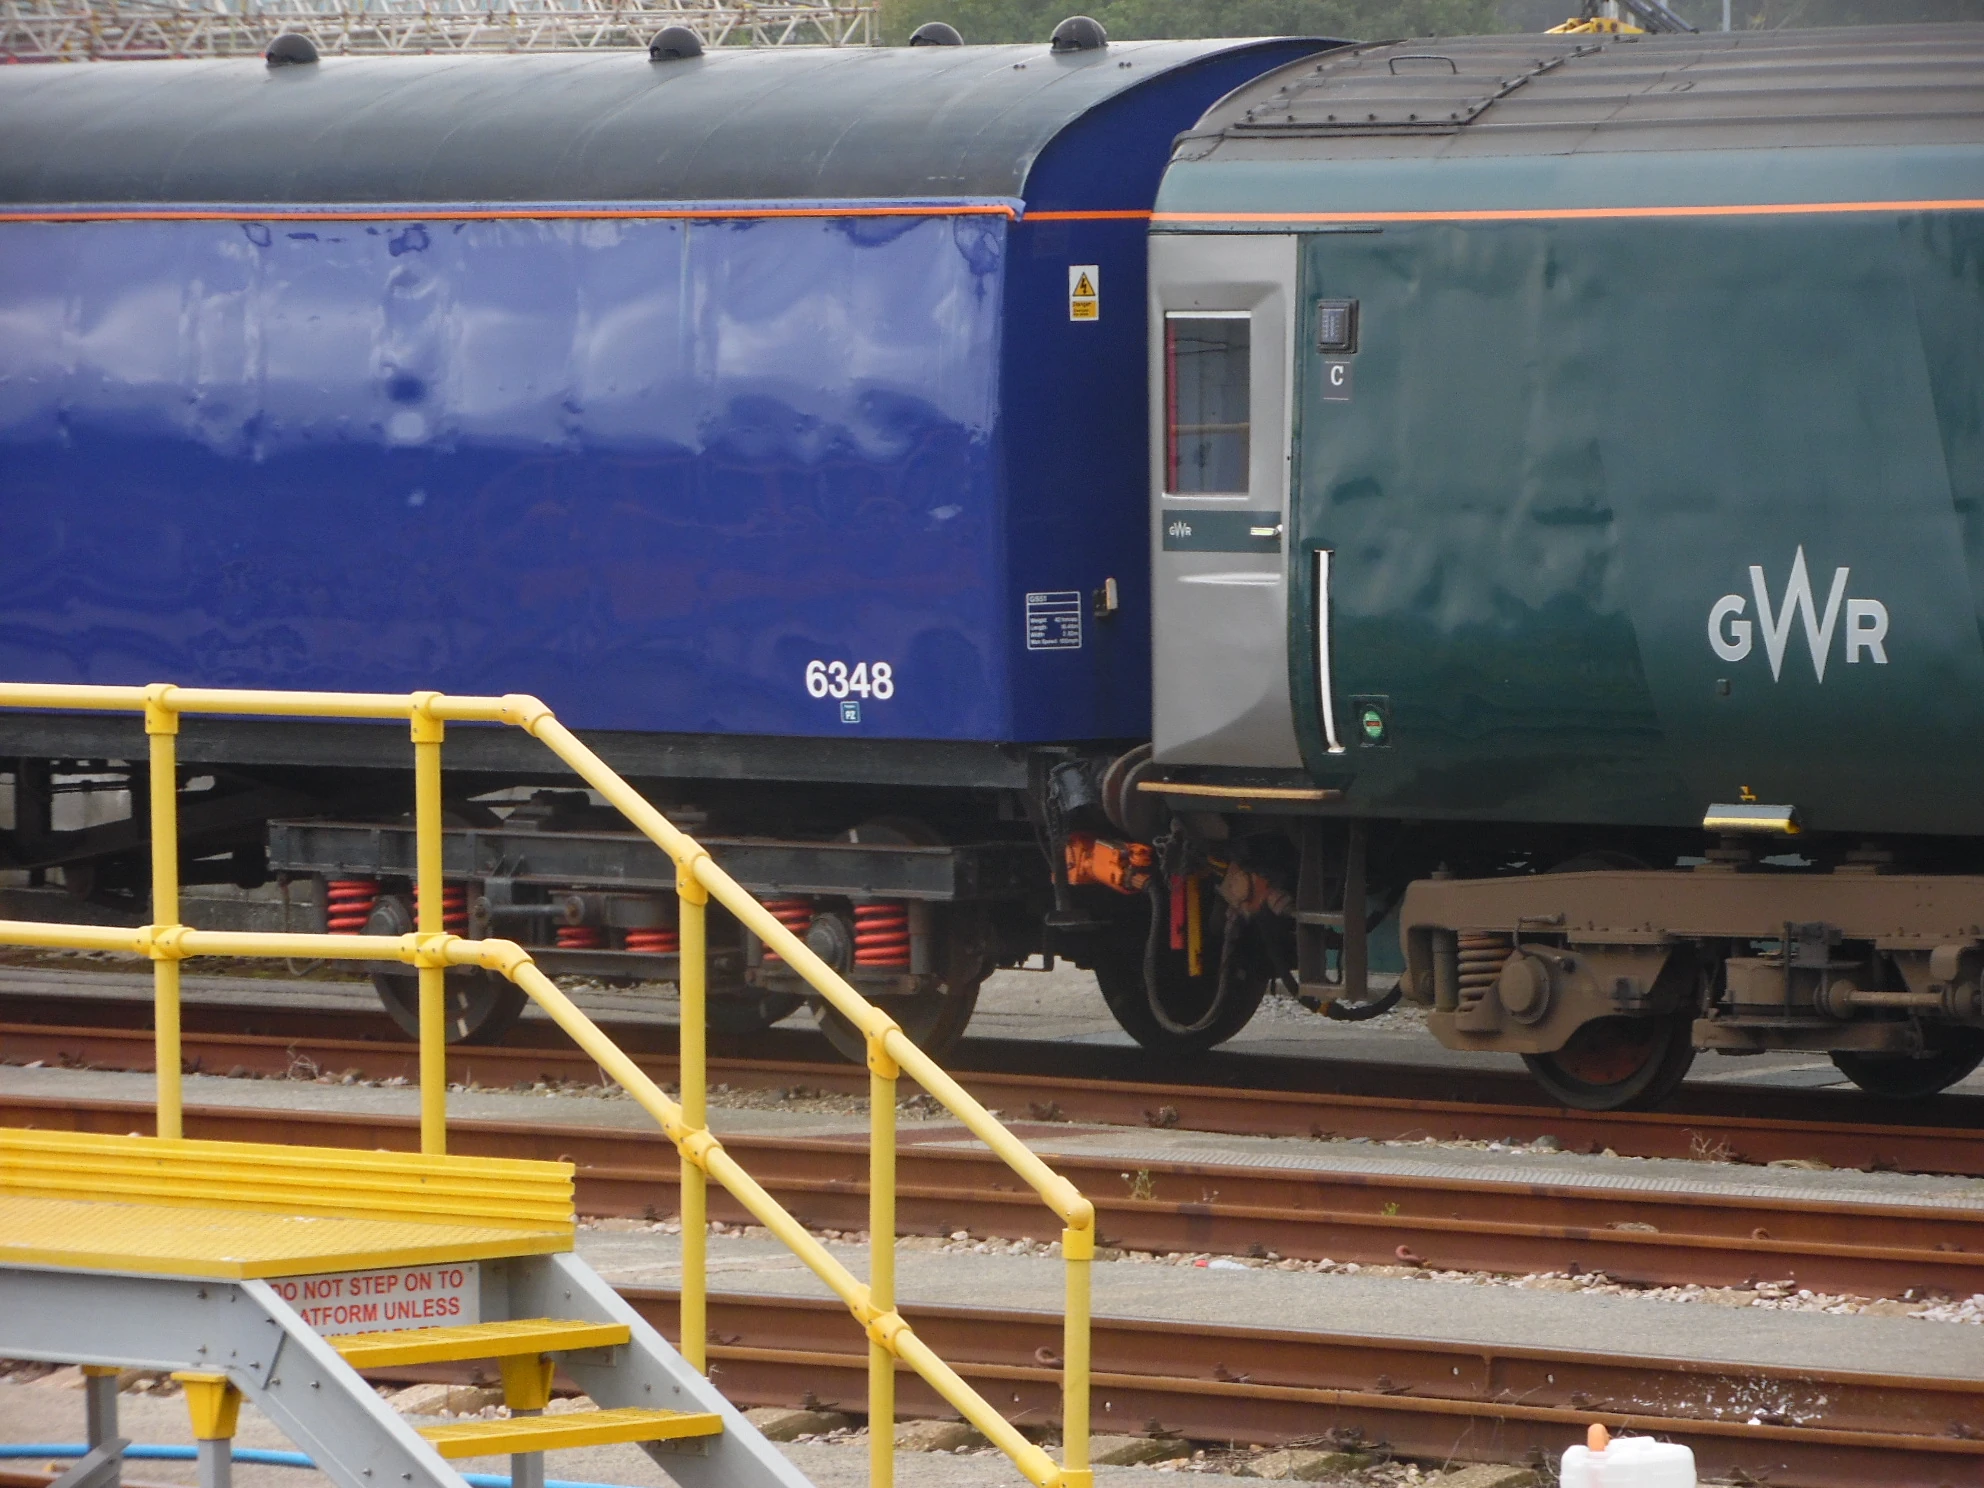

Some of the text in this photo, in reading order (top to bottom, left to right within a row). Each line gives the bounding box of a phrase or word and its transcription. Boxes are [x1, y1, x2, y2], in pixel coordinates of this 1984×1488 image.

[1330, 365, 1344, 386] C
[1168, 521, 1192, 539] GWR
[1708, 543, 1889, 685] GWR
[805, 660, 894, 700] 6348
[845, 710, 857, 720] PZ
[304, 1278, 343, 1300] NOT
[350, 1274, 398, 1297] STEP
[404, 1271, 432, 1292] ON
[438, 1269, 464, 1289] TO
[300, 1296, 461, 1327] ATFORM UNLESS
